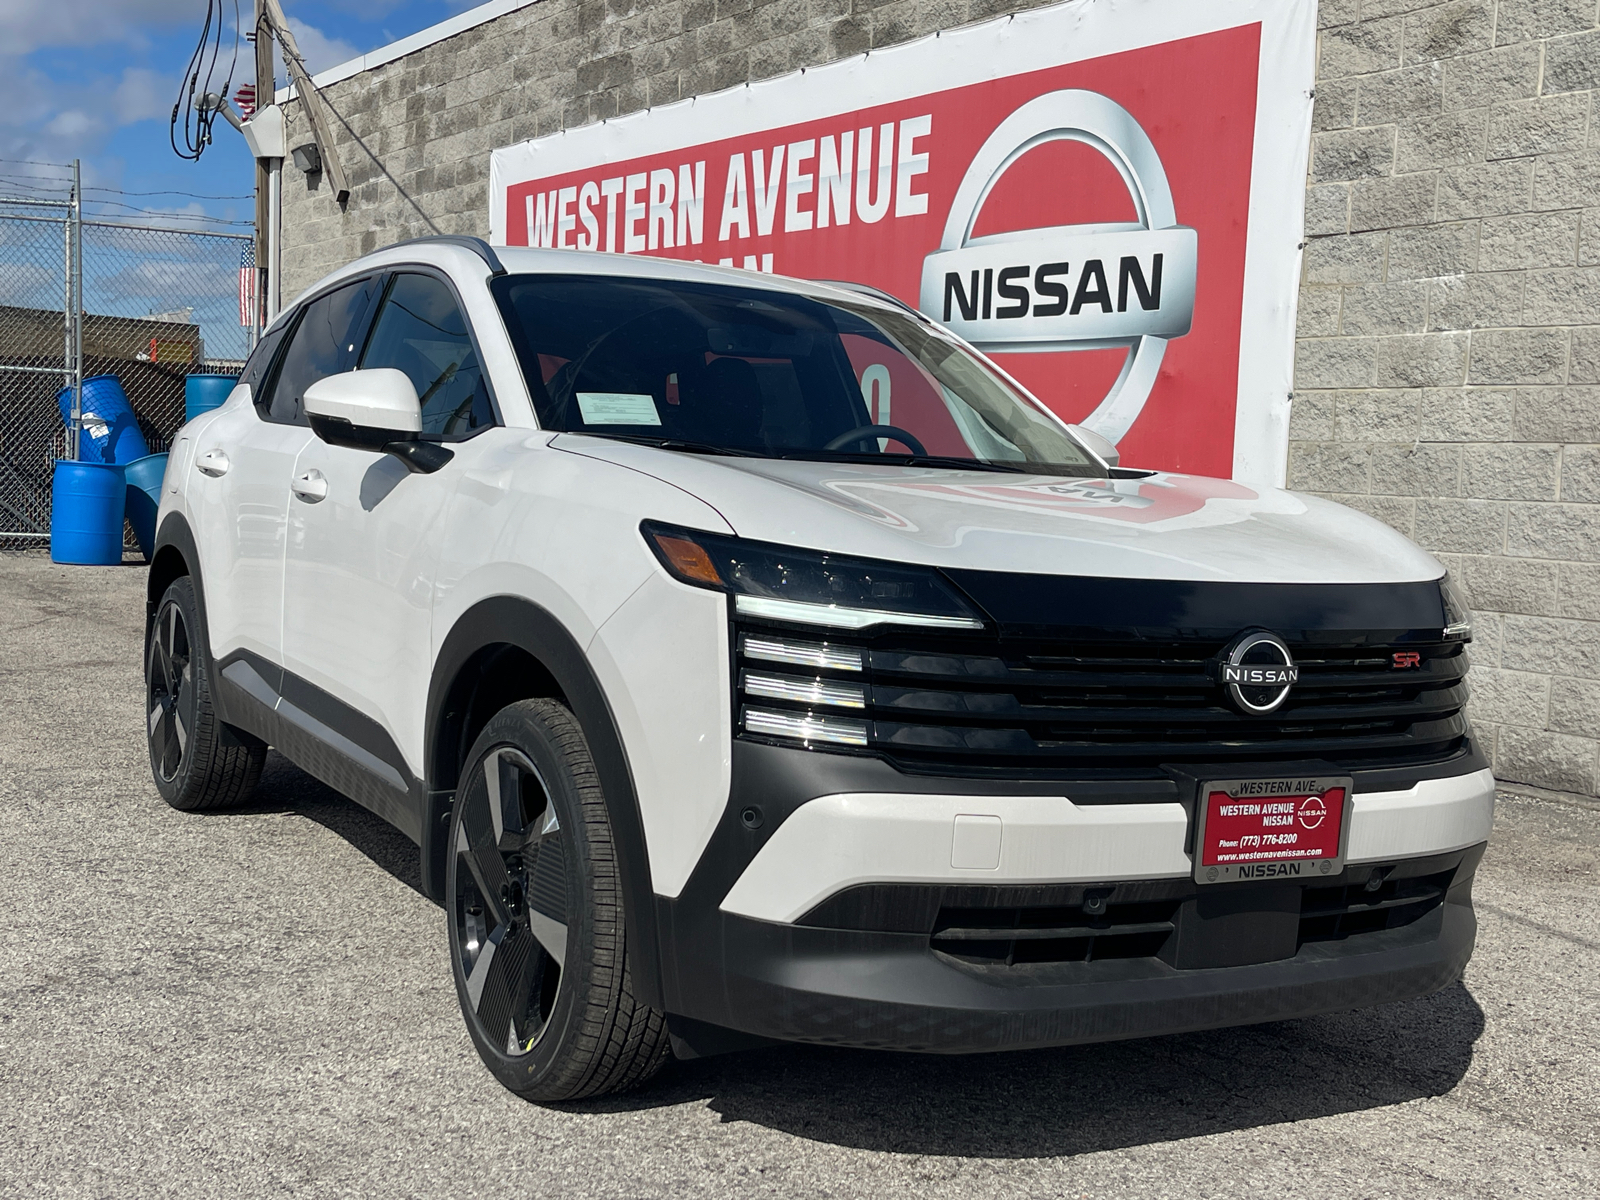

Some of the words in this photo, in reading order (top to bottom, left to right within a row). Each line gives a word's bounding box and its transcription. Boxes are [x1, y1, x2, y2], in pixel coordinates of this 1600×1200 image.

[525, 161, 705, 253] WESTERN
[718, 114, 934, 241] AVENUE
[943, 253, 1164, 322] NISSAN
[1392, 651, 1421, 668] SR
[1226, 668, 1298, 682] NISSAN
[1240, 781, 1292, 794] WESTERN
[1220, 805, 1260, 816] WESTERN
[1261, 803, 1295, 814] AVENUE
[1263, 815, 1294, 826] NISSAN
[1218, 840, 1238, 848] Phone:
[1240, 835, 1260, 849] (773)
[1261, 833, 1298, 845] 776-8200
[1217, 849, 1322, 861] www.westernavenissan.com
[1239, 863, 1301, 878] NISSAN
